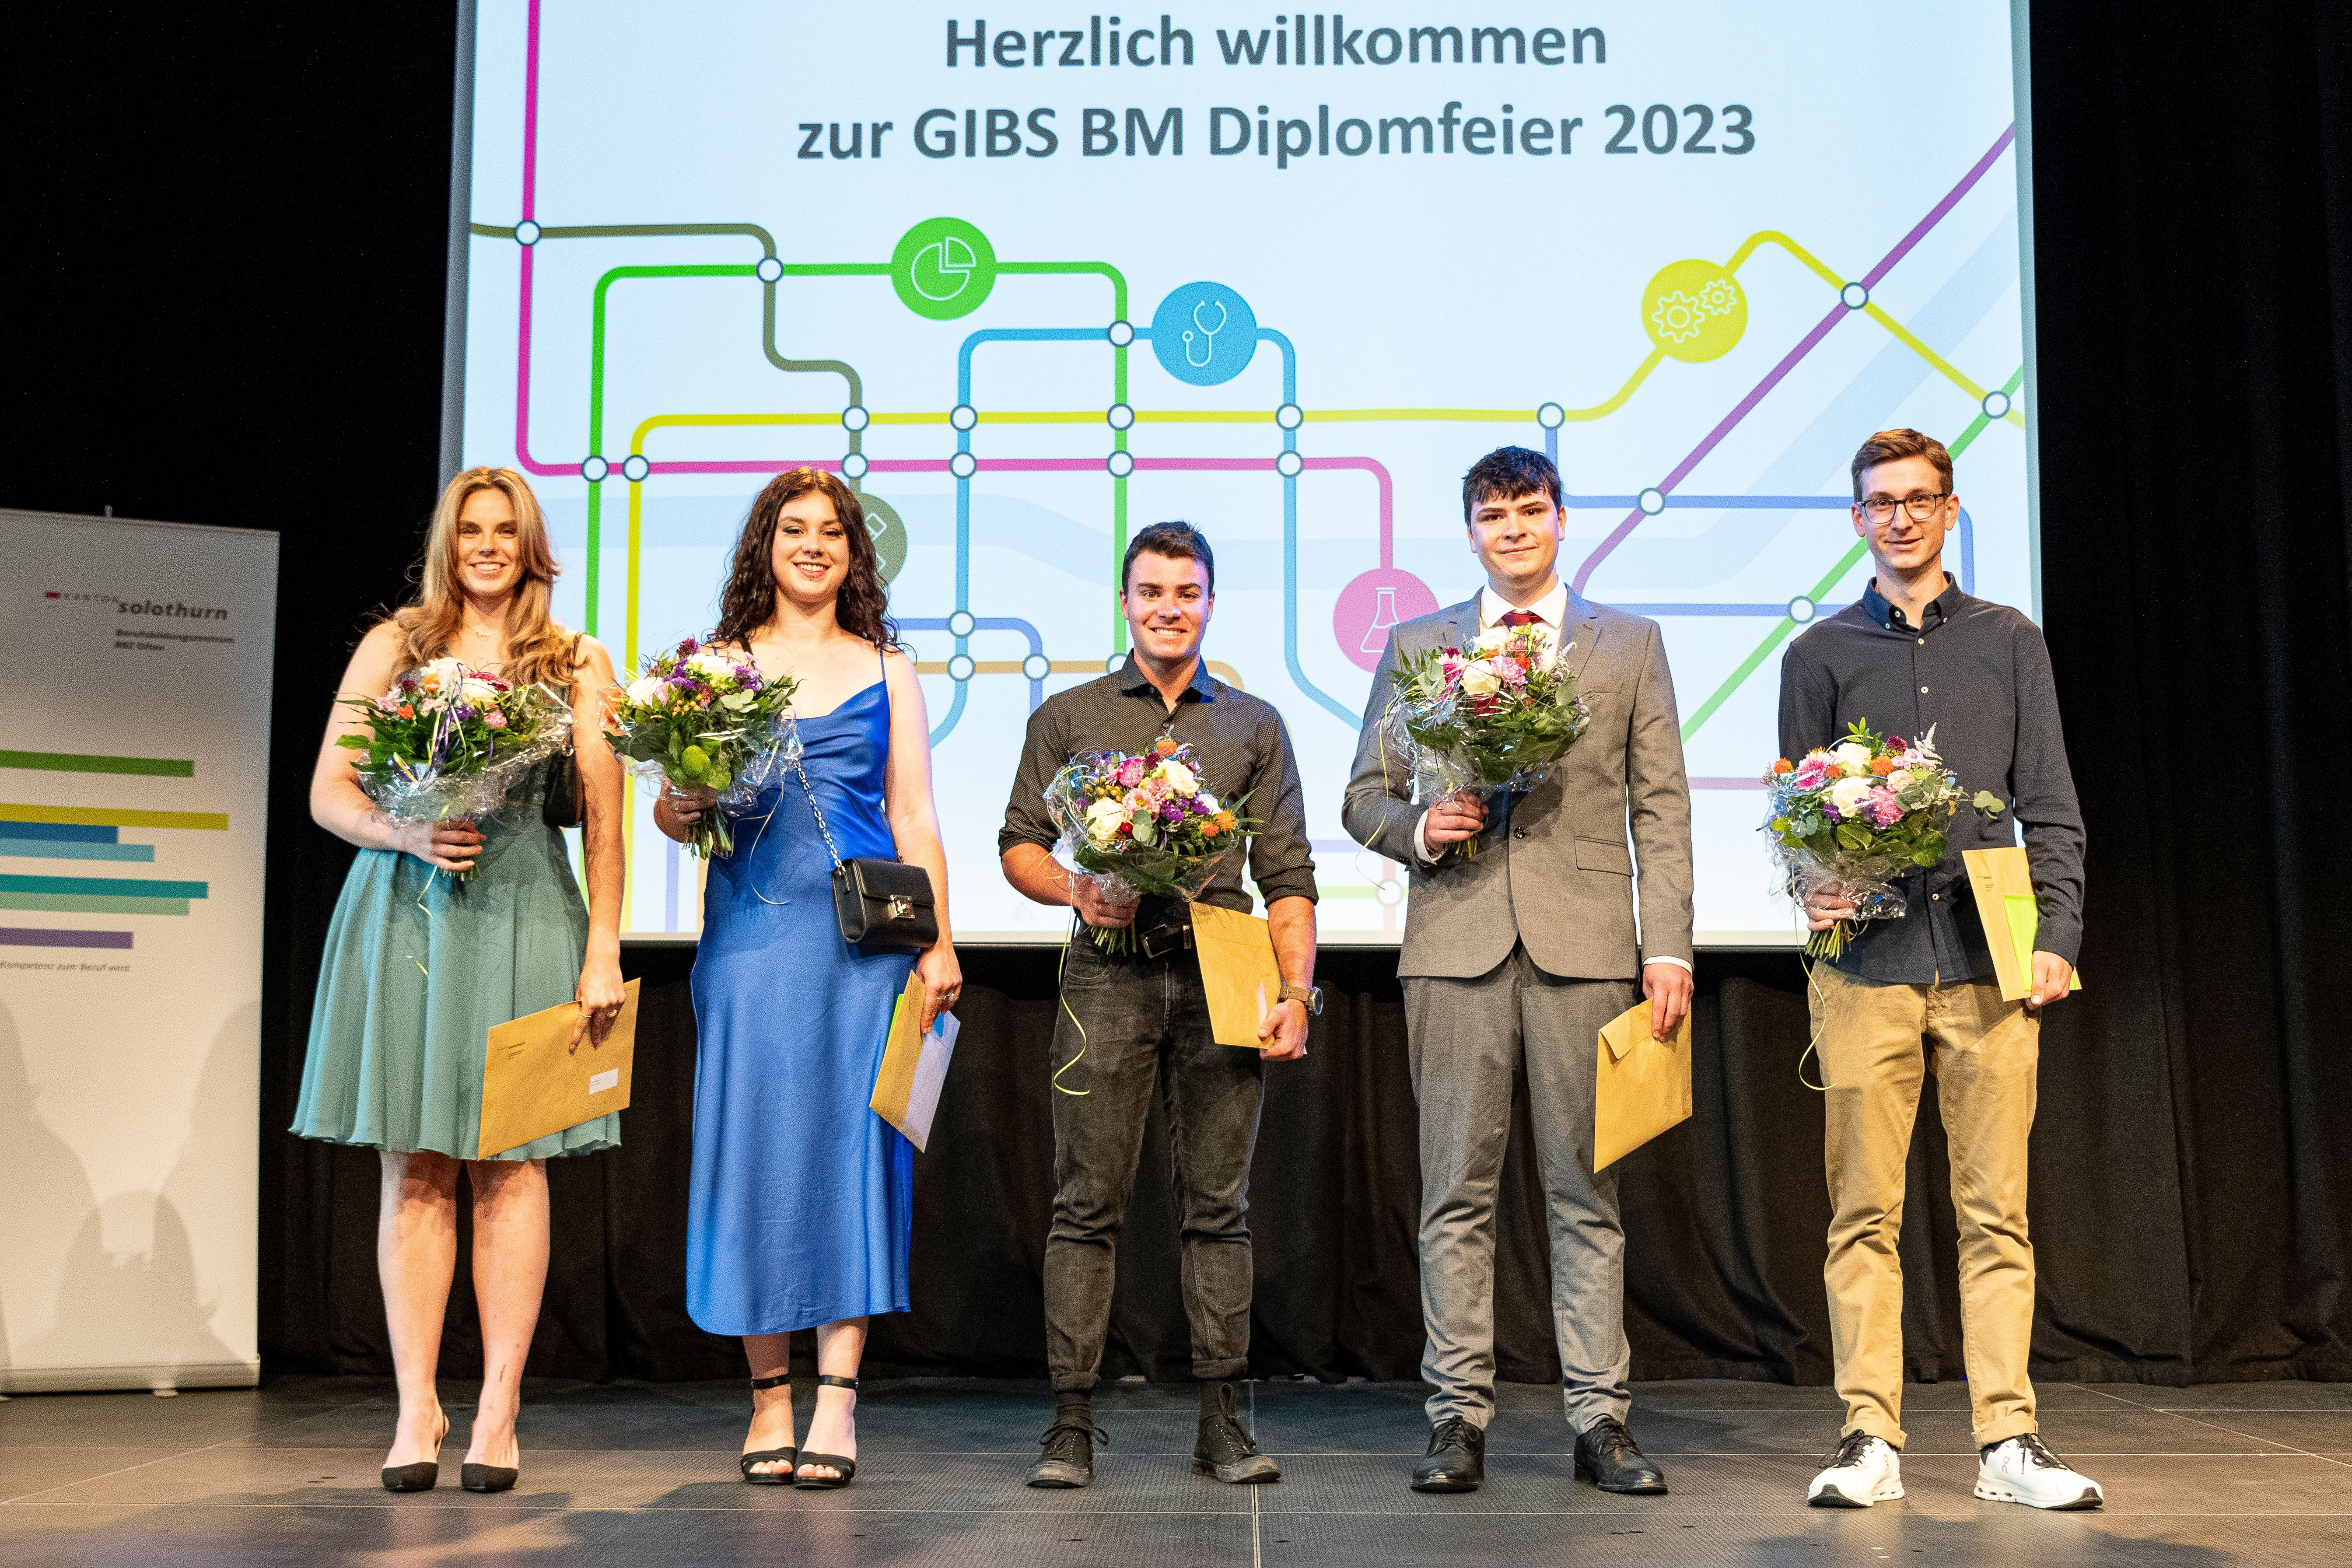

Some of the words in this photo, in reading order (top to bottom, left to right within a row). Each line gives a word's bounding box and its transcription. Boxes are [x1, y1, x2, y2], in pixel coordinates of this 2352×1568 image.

[947, 15, 1193, 67] Herzlich
[1216, 14, 1606, 65] willkommen
[797, 121, 893, 159] zur
[914, 107, 1058, 158] GIBS
[1083, 107, 1183, 156] BM
[1210, 101, 1582, 169] Diplomfeier
[1605, 104, 1755, 154] 2023
[118, 601, 228, 620] solothurn
